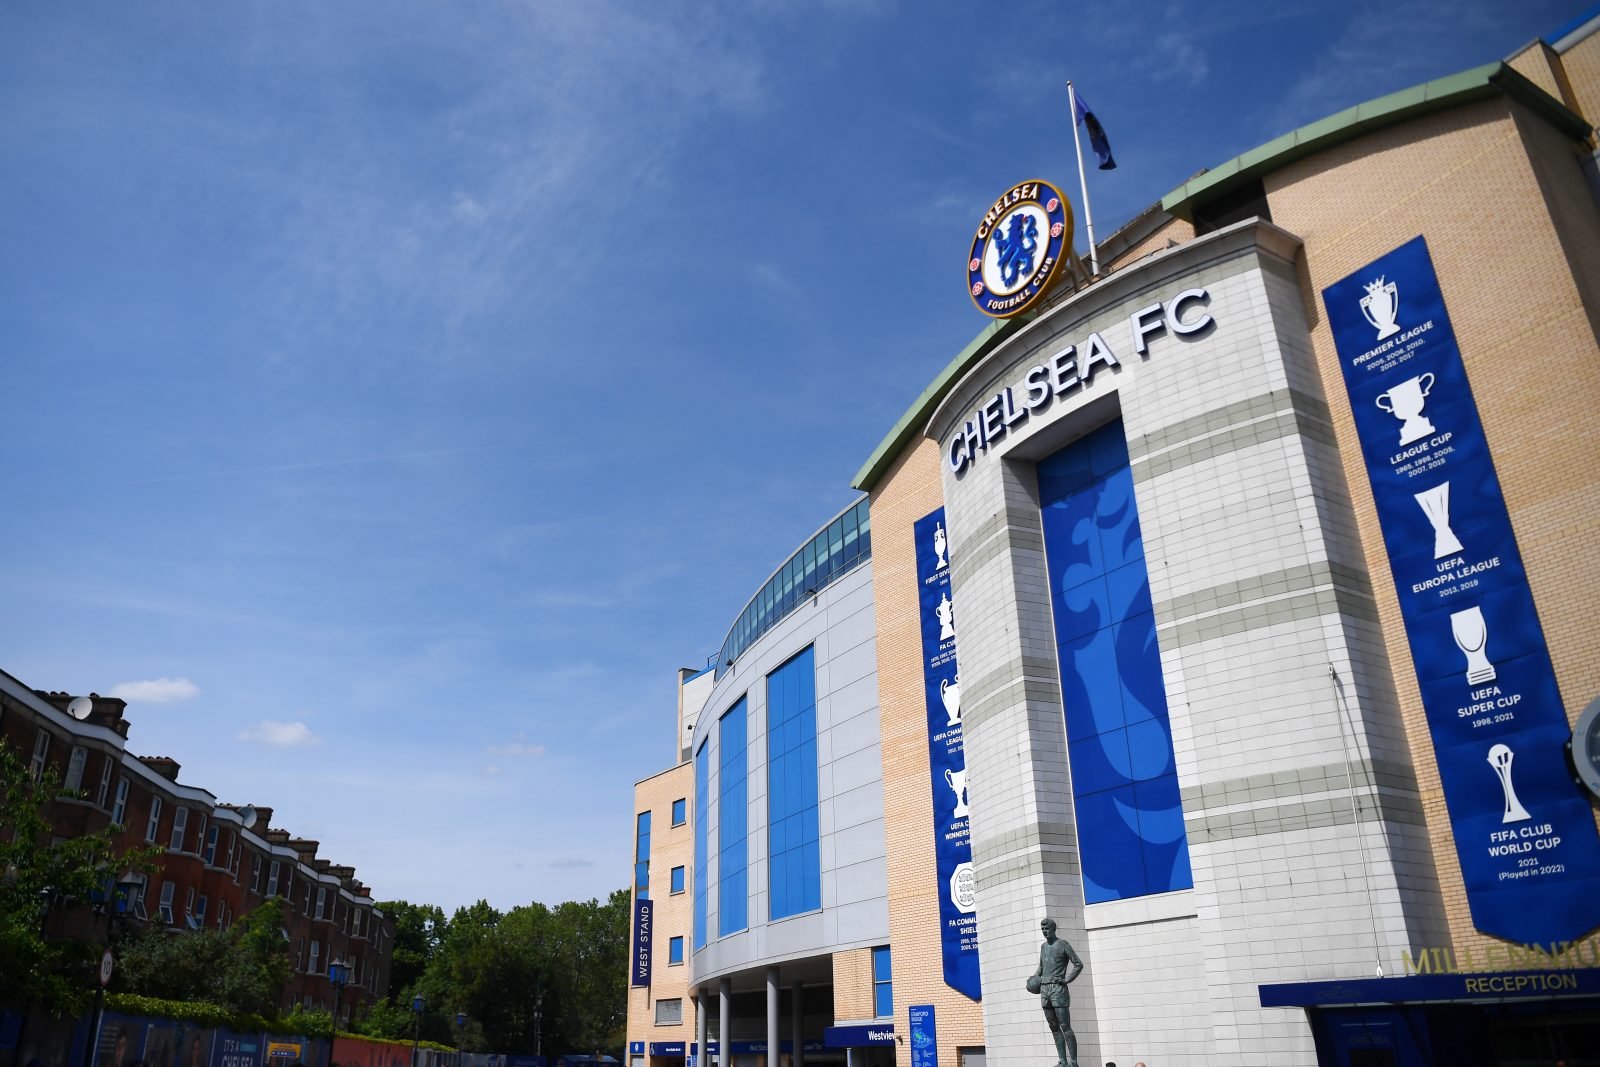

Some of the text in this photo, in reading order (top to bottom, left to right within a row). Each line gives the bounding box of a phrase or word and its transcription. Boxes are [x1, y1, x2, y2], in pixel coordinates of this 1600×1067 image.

[977, 184, 1039, 239] CHELSEA
[987, 257, 1053, 310] FOOTBALL CLUB
[1352, 320, 1434, 366] PREMIER LEAGUE
[1406, 338, 1426, 351] 2010,
[1398, 351, 1415, 363] 2017
[948, 288, 1215, 473] CHELSEA FC
[1390, 432, 1452, 465] LEAGUE CUP
[1436, 556, 1465, 572] UEFA
[1411, 556, 1501, 593] EUROPA LEAGUE
[1439, 579, 1479, 598] 2013, 2019
[1471, 686, 1502, 701] UEFA
[1457, 694, 1521, 718] SUPER CUP
[1494, 712, 1515, 723] 2021
[1490, 823, 1553, 843] FIFA CLUB
[1488, 837, 1561, 857] WORLD CUP
[1498, 864, 1565, 881] (Played in 2022)
[1517, 857, 1540, 868] 2021
[639, 906, 649, 978] WEST STAND
[1465, 973, 1578, 993] RECEPTION
